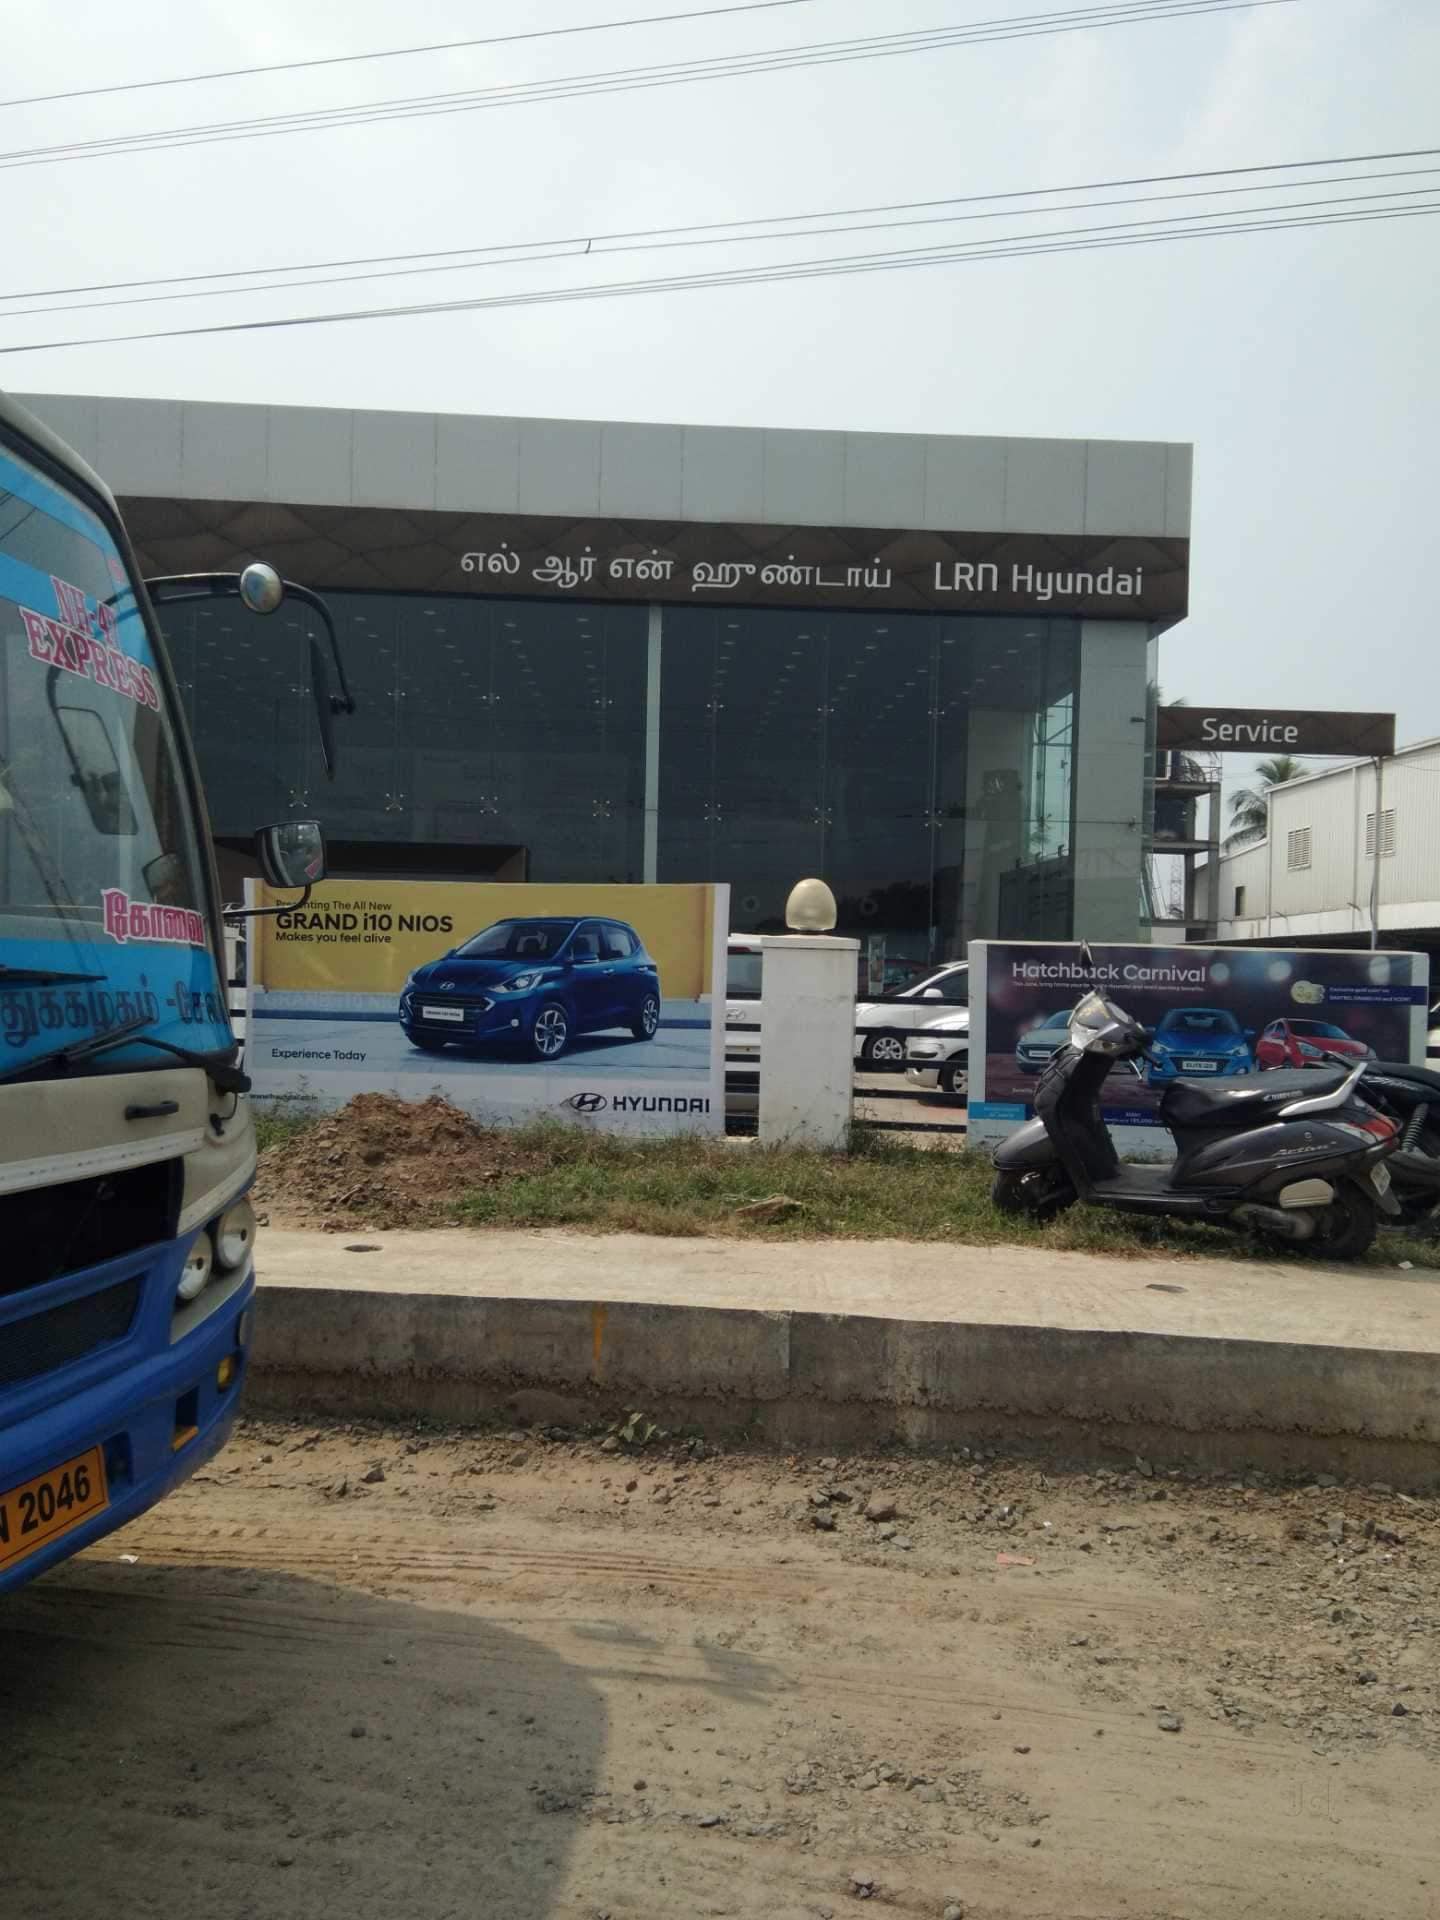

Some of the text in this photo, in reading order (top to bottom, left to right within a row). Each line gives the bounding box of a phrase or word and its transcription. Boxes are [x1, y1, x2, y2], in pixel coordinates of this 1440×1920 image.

[460, 542, 520, 574] எல்
[532, 546, 597, 588] ஆர்
[609, 548, 674, 580] என்
[934, 562, 1143, 600] LRN Hyundai
[20, 607, 160, 711] EXPRESS
[1202, 717, 1298, 743] Service
[332, 900, 350, 911] The
[353, 901, 366, 911] All
[369, 901, 392, 911] New
[276, 912, 453, 932] GRAND i10 NIOS
[276, 932, 392, 944] Makes you feel alive
[1012, 962, 1206, 982] Hatchback Carnival
[271, 1048, 367, 1062] Experience Today
[613, 1096, 710, 1113] HYUNDAI
[18, 1464, 90, 1535] 2046
